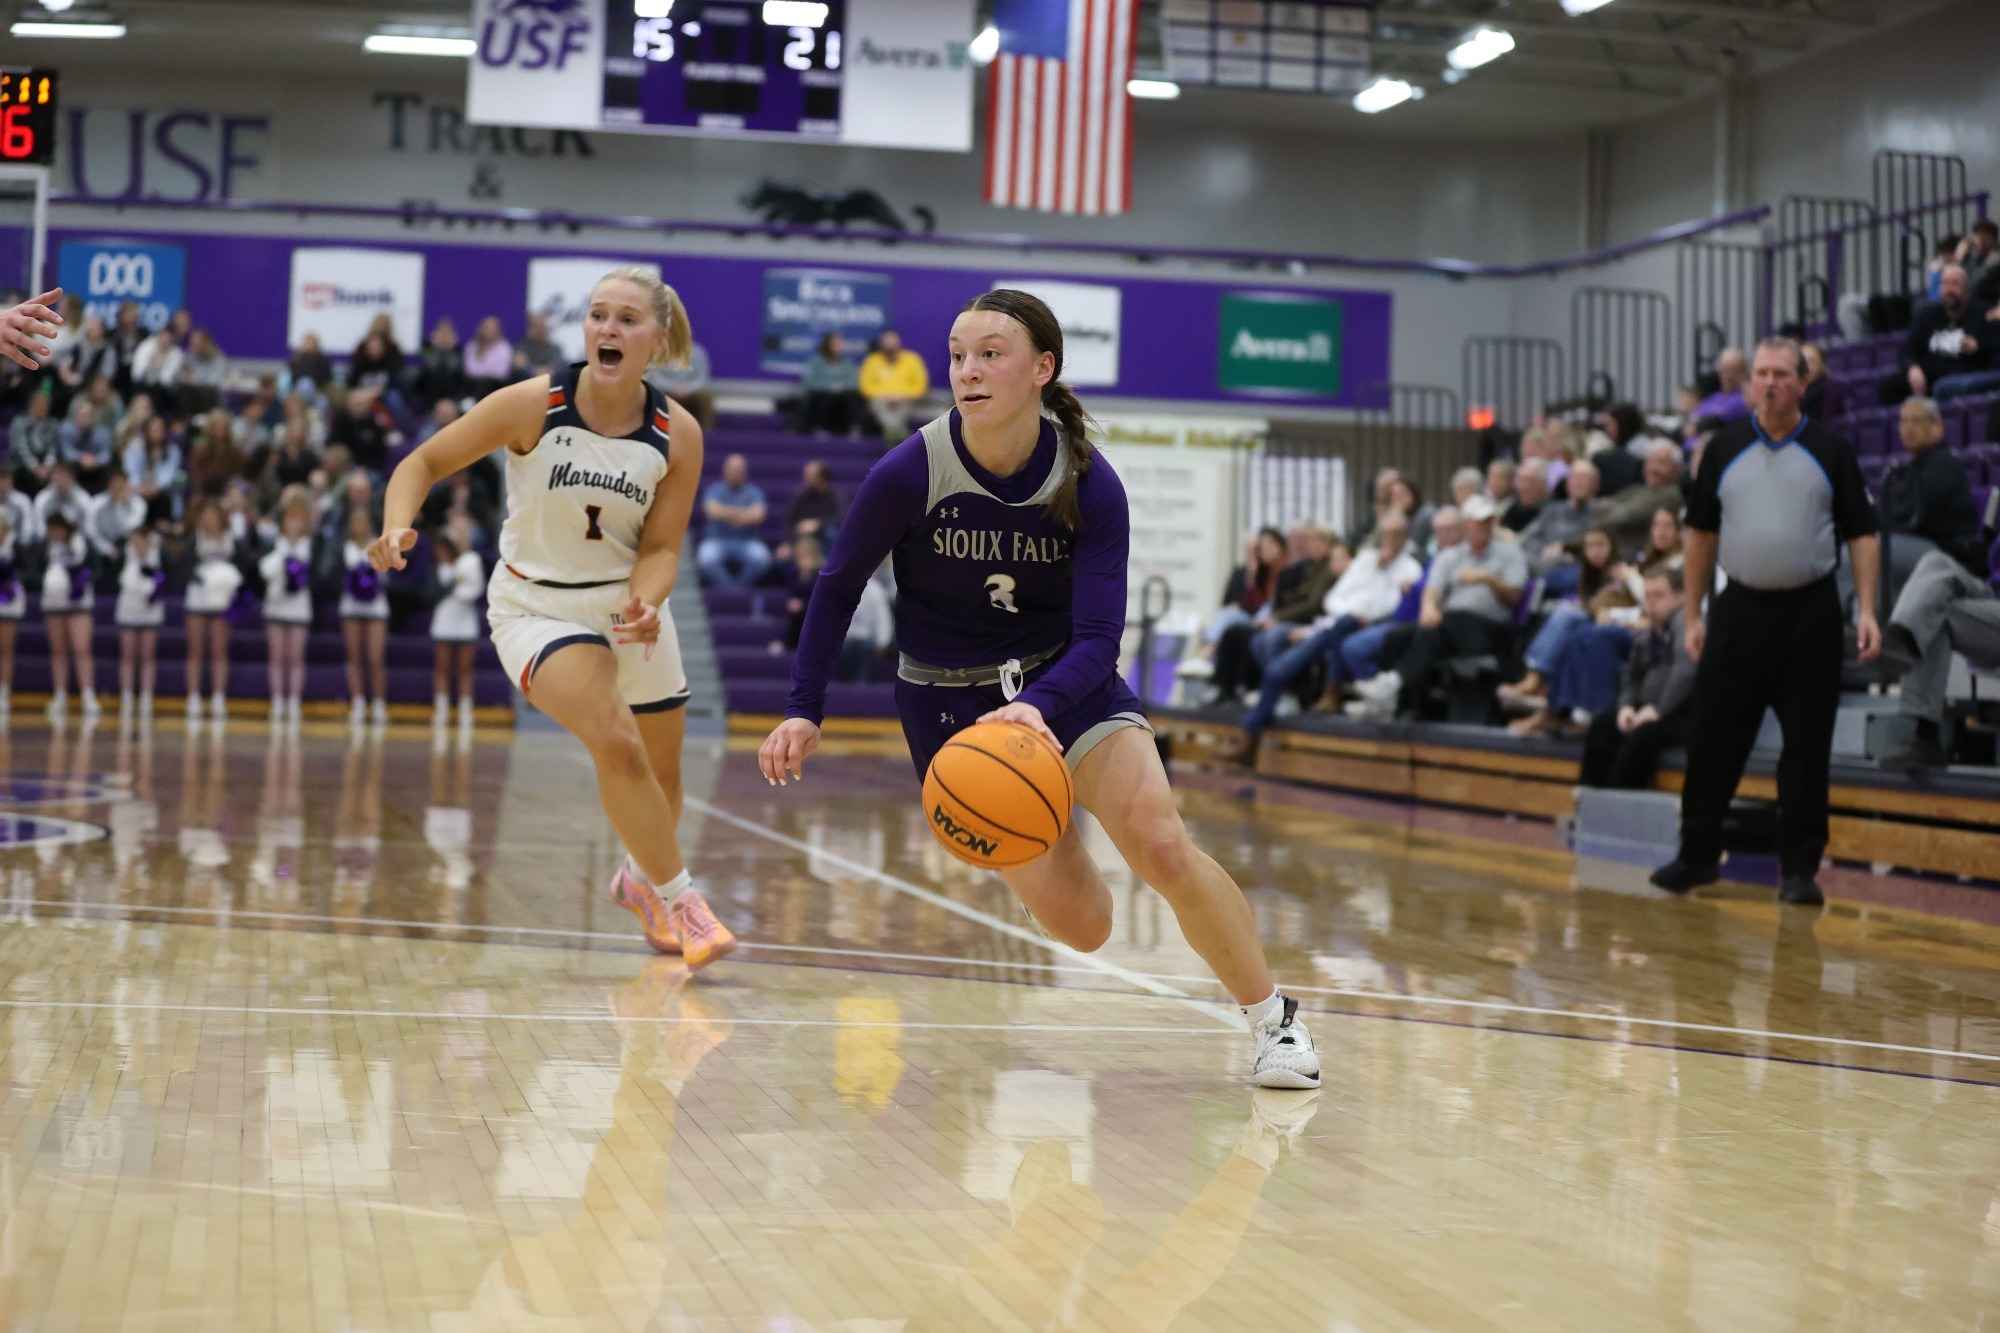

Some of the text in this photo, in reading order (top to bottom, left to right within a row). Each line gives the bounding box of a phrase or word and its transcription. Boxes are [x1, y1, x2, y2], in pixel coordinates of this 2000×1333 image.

[480, 19, 592, 71] USF
[633, 17, 675, 62] 15
[783, 26, 842, 70] 21
[851, 36, 941, 70] Avera
[0, 104, 35, 157] 6
[65, 106, 270, 204] USF
[549, 462, 648, 506] Marauders
[933, 527, 1003, 561] SIOUX
[933, 804, 1000, 857] NCAA
